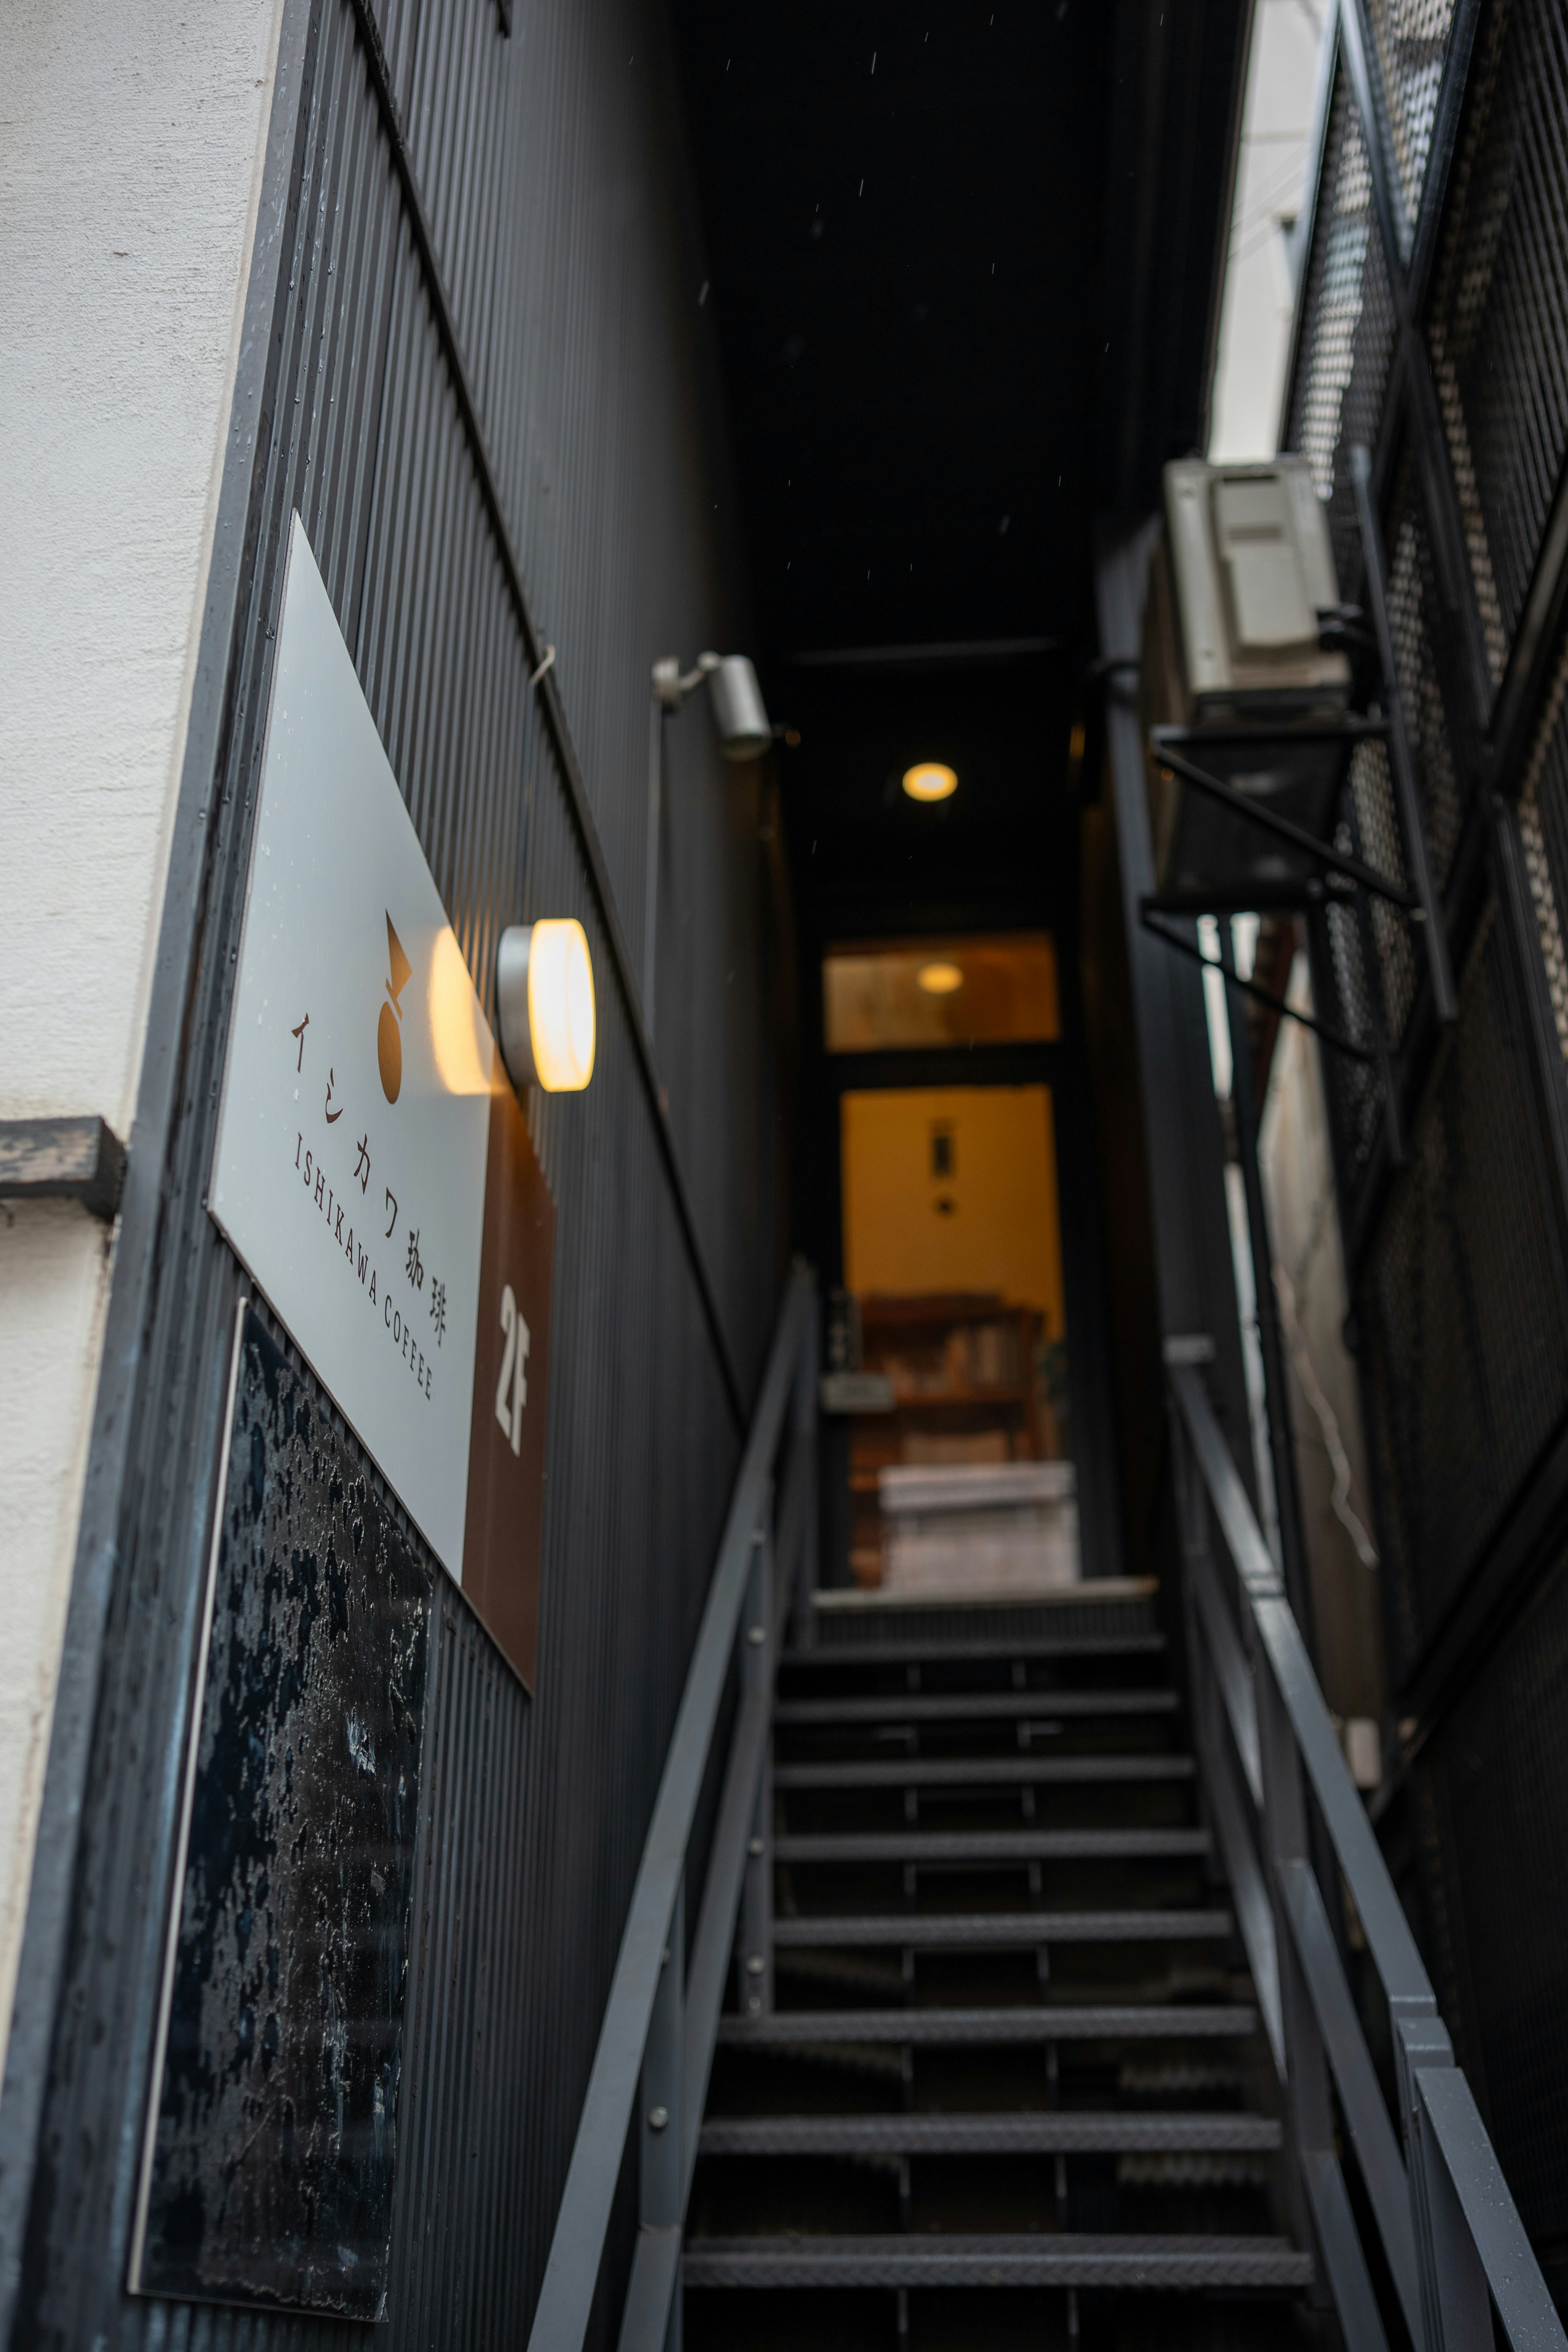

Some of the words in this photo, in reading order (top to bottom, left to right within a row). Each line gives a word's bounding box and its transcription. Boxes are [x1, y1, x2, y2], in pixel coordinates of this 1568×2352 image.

[295, 1132, 376, 1306] ISHIKAWA
[385, 1294, 432, 1401] COFFEE
[494, 1283, 531, 1458] 2F
